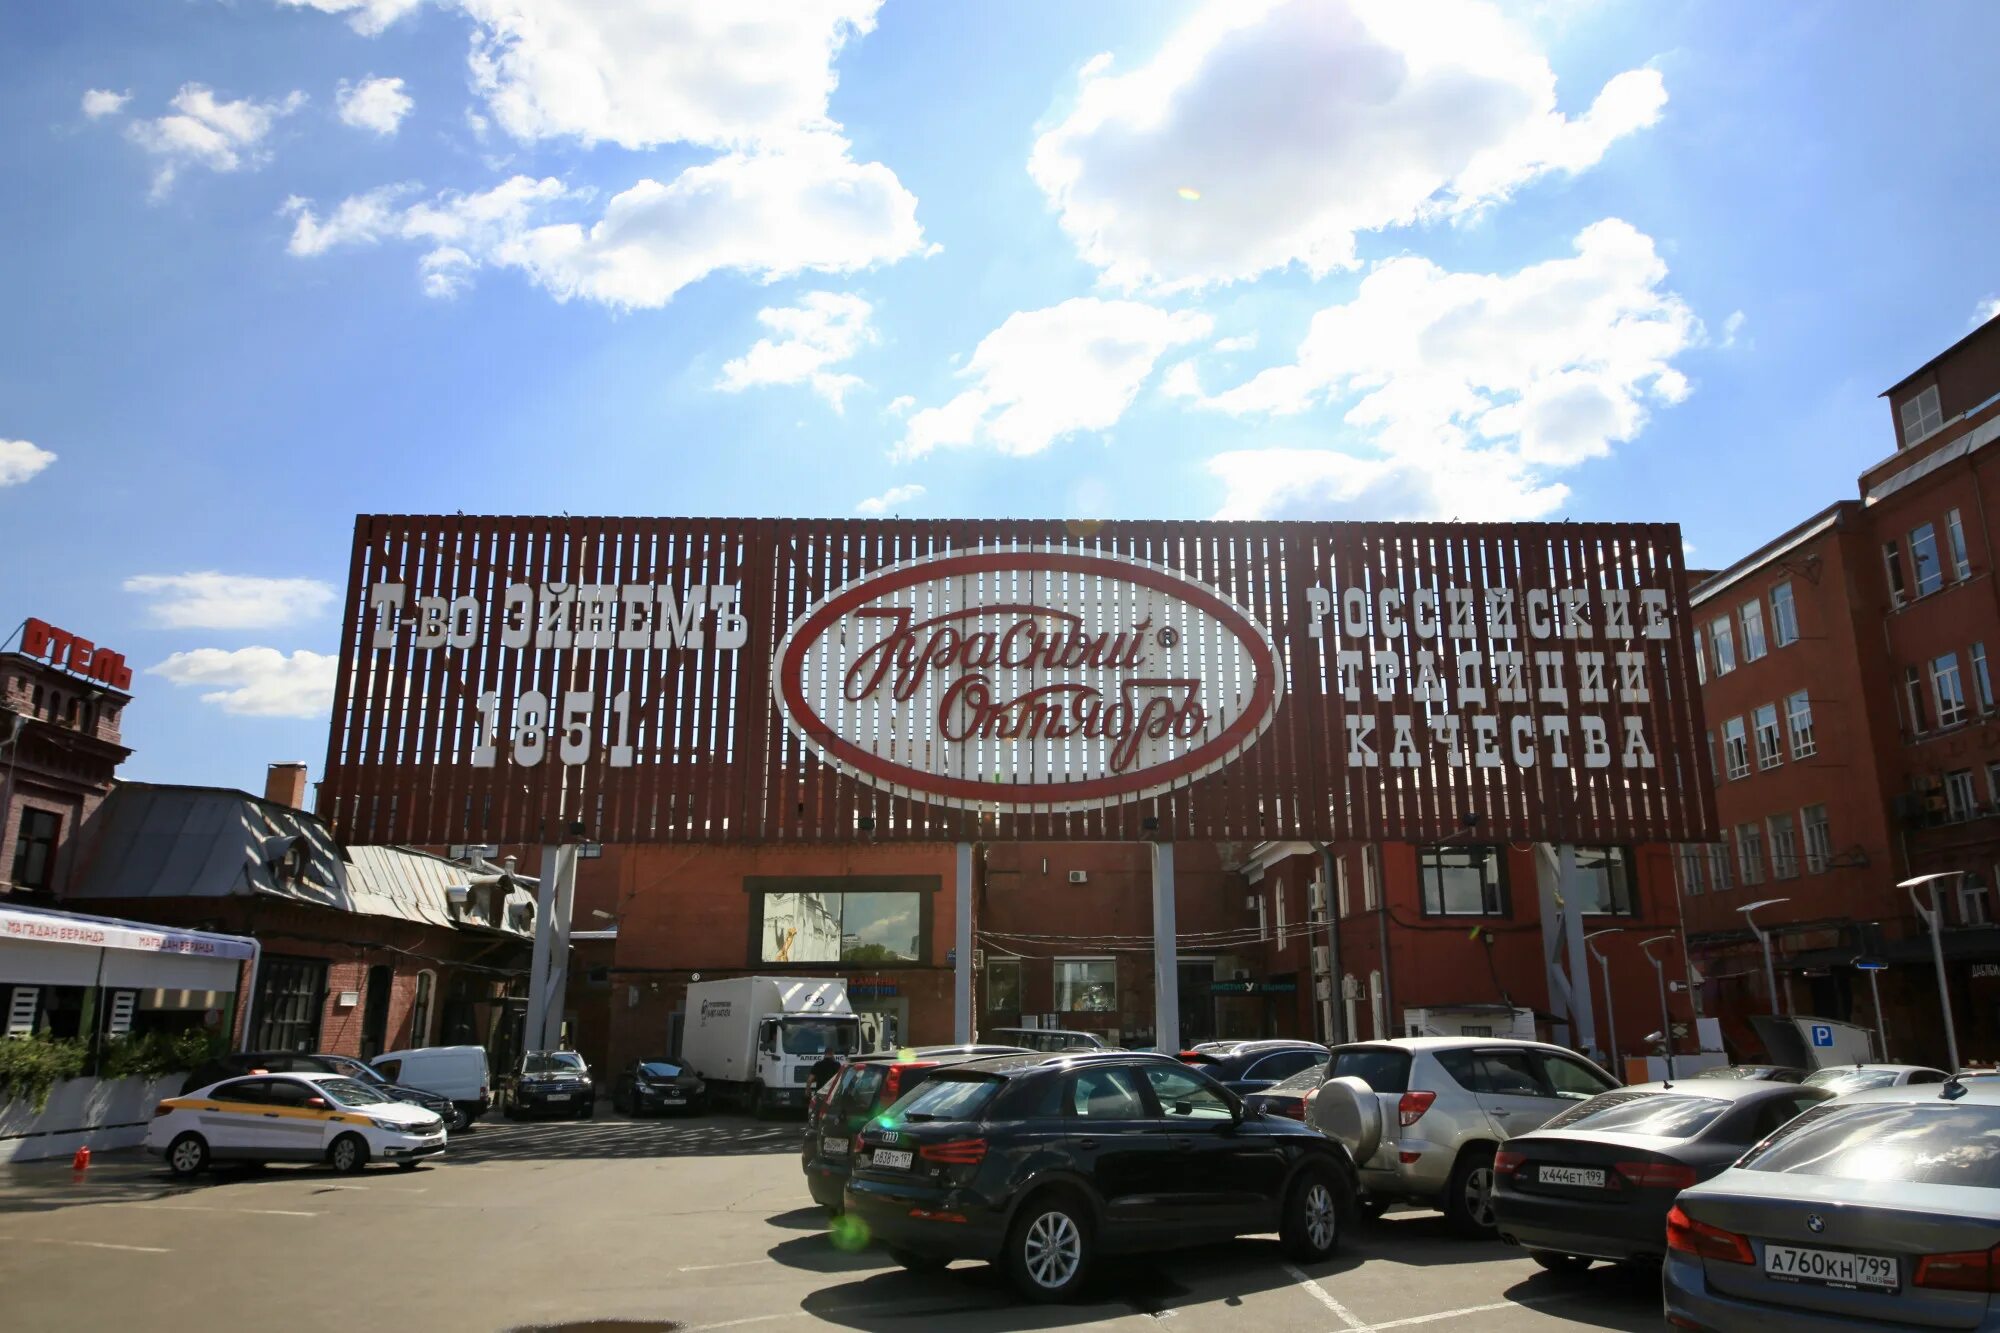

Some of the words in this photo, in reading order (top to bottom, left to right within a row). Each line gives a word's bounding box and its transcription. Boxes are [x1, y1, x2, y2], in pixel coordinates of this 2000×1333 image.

[501, 582, 748, 649] ЭЙНЕМЪ
[1306, 587, 1671, 640] РОССИЙСКИЕ
[20, 617, 133, 690] ОТЕЛЬ
[844, 603, 1151, 702] Красный
[1338, 650, 1650, 709] ТРАДИЦИИ
[472, 690, 634, 767] 1851
[939, 673, 1212, 773] Октябрь
[1345, 714, 1655, 768] КАЧЕСТВА
[7, 920, 59, 938] МАГАДАН
[60, 927, 105, 943] ВЕРАНДА
[138, 936, 179, 950] МАГАДАН
[180, 938, 215, 953] ВЕРАНДА
[1817, 1027, 1829, 1044] P
[1585, 1170, 1602, 1182] 199
[1771, 1250, 1853, 1279] А760КН
[1857, 1256, 1891, 1277] 799
[1866, 1275, 1884, 1284] RUS
